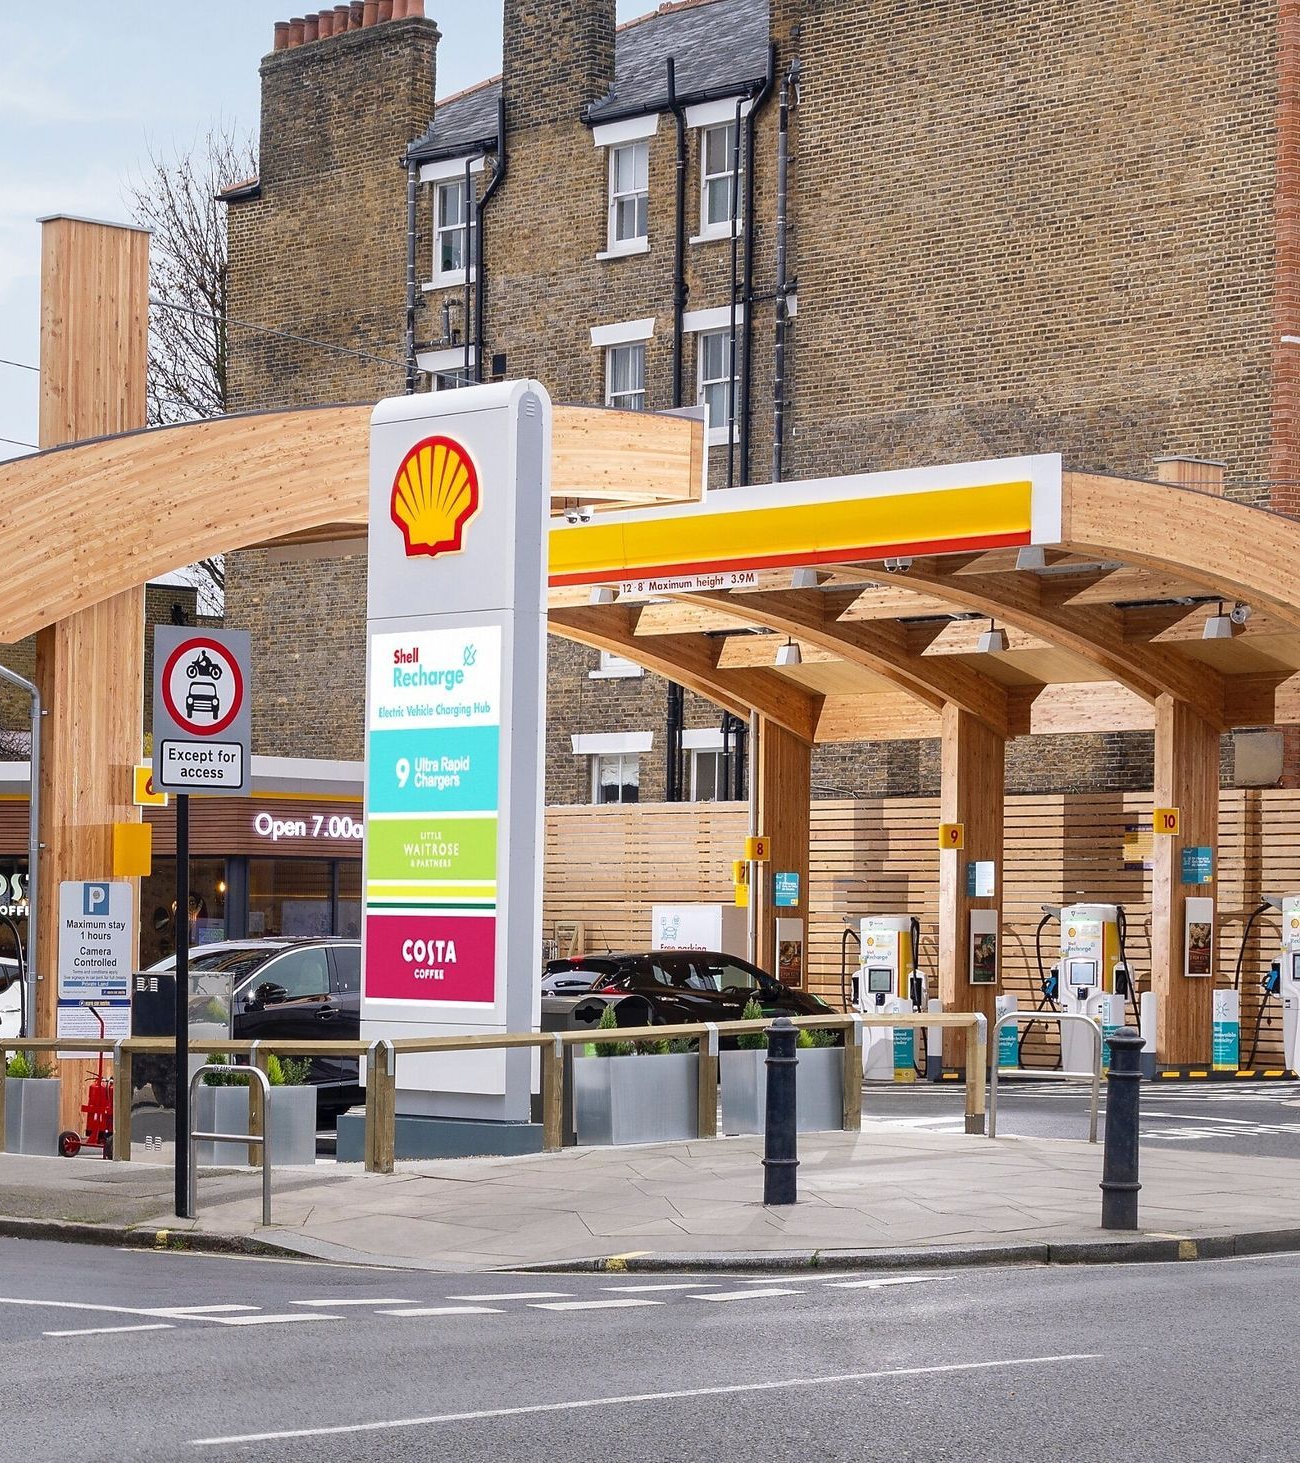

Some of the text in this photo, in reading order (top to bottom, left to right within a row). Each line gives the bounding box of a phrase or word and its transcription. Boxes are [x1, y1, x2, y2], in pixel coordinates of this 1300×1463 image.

[649, 580, 692, 591] Maximum
[696, 576, 724, 588] height
[731, 573, 755, 584] 3.9M
[394, 647, 419, 664] Shell
[393, 664, 464, 691] Recharge
[378, 701, 491, 718] Electric Vehicle Charging Hub
[168, 748, 236, 763] Except for
[414, 755, 470, 774] Ultra Rapid
[180, 766, 224, 779] access
[396, 758, 410, 788] 9
[414, 772, 460, 791] Chargers
[255, 813, 364, 840] Open 7.00a
[1163, 814, 1175, 829] 10
[420, 832, 442, 840] LITTLE
[950, 830, 958, 843] 9
[404, 843, 459, 856] WAITROSE
[757, 842, 764, 855] 8
[416, 859, 452, 868] PARTNERS
[66, 919, 126, 931] Maximum stay
[88, 931, 111, 940] hours
[80, 946, 112, 956] Camera
[402, 939, 457, 966] COSTA
[73, 957, 117, 967] Controlled
[414, 968, 444, 980] COFFEE
